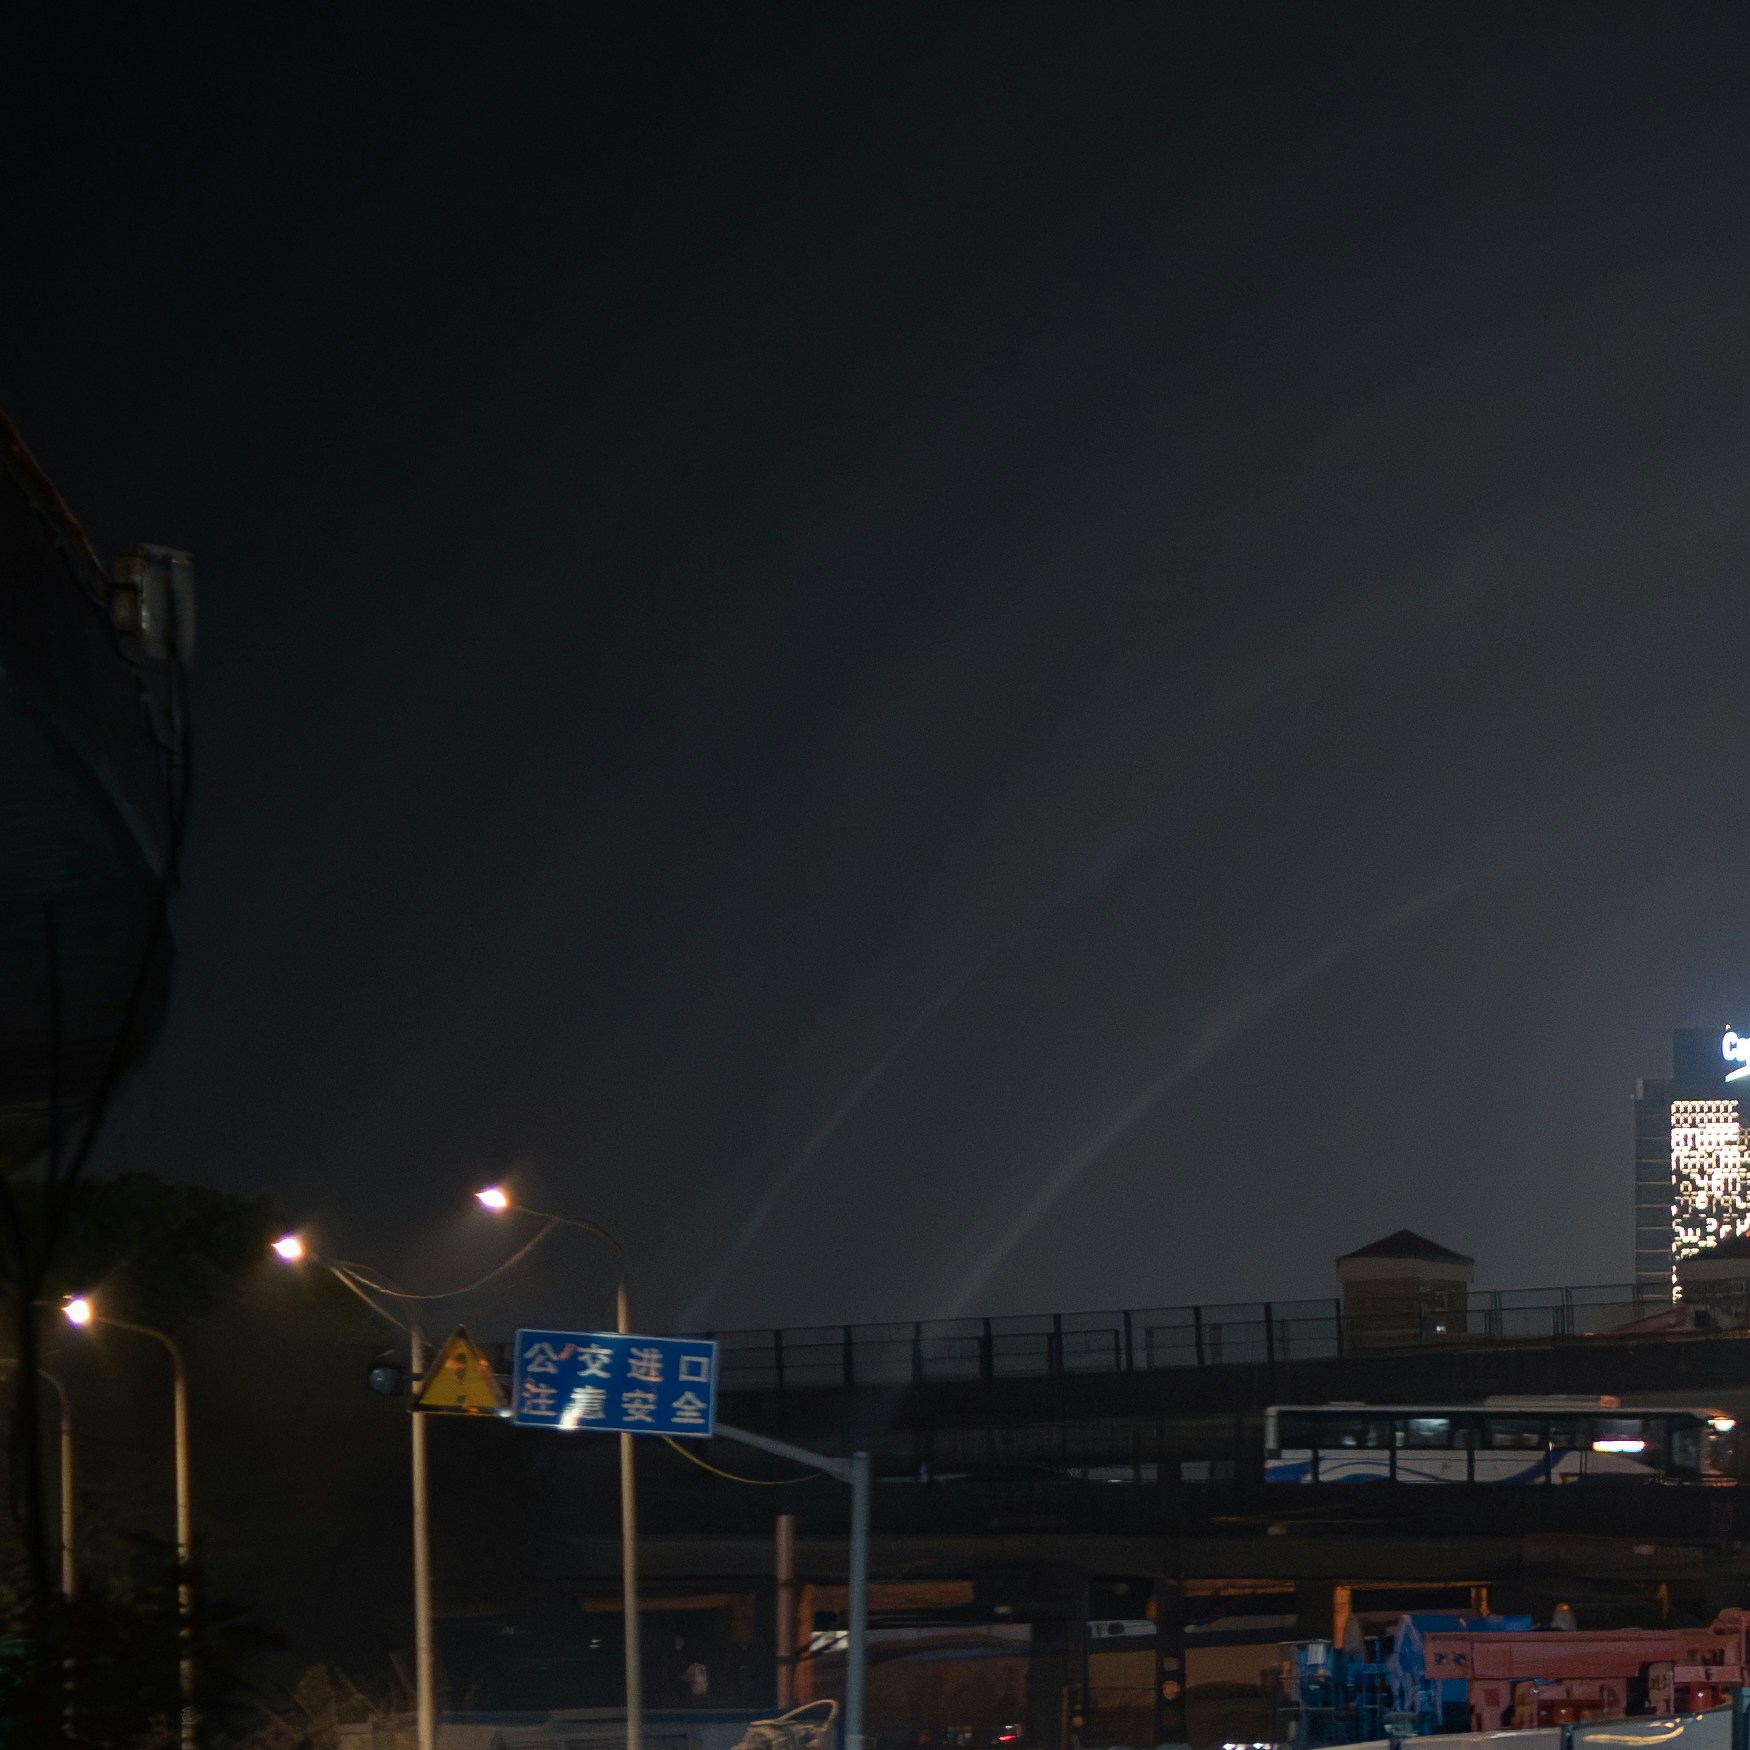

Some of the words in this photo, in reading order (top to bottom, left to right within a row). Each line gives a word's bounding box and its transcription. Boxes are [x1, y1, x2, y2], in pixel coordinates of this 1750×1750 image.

[523, 1342, 710, 1383] 公交进口
[521, 1379, 707, 1425] 注意安全
